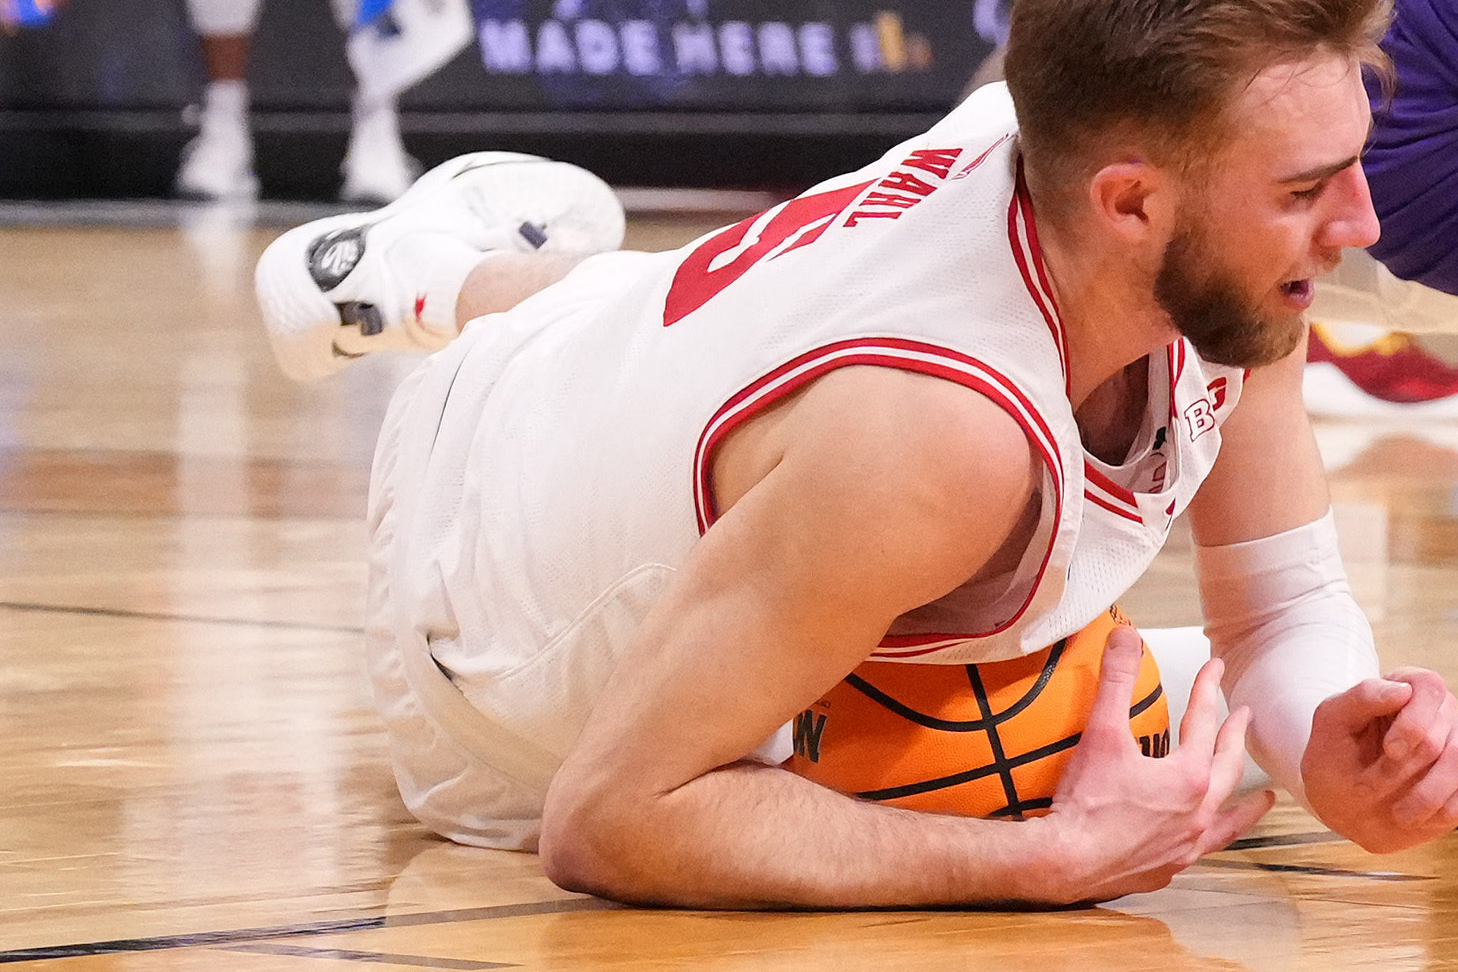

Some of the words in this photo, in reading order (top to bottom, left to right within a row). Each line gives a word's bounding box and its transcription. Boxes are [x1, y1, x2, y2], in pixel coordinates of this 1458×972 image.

[478, 18, 661, 76] MADE
[673, 21, 839, 77] HERE
[843, 147, 964, 228] WAHL
